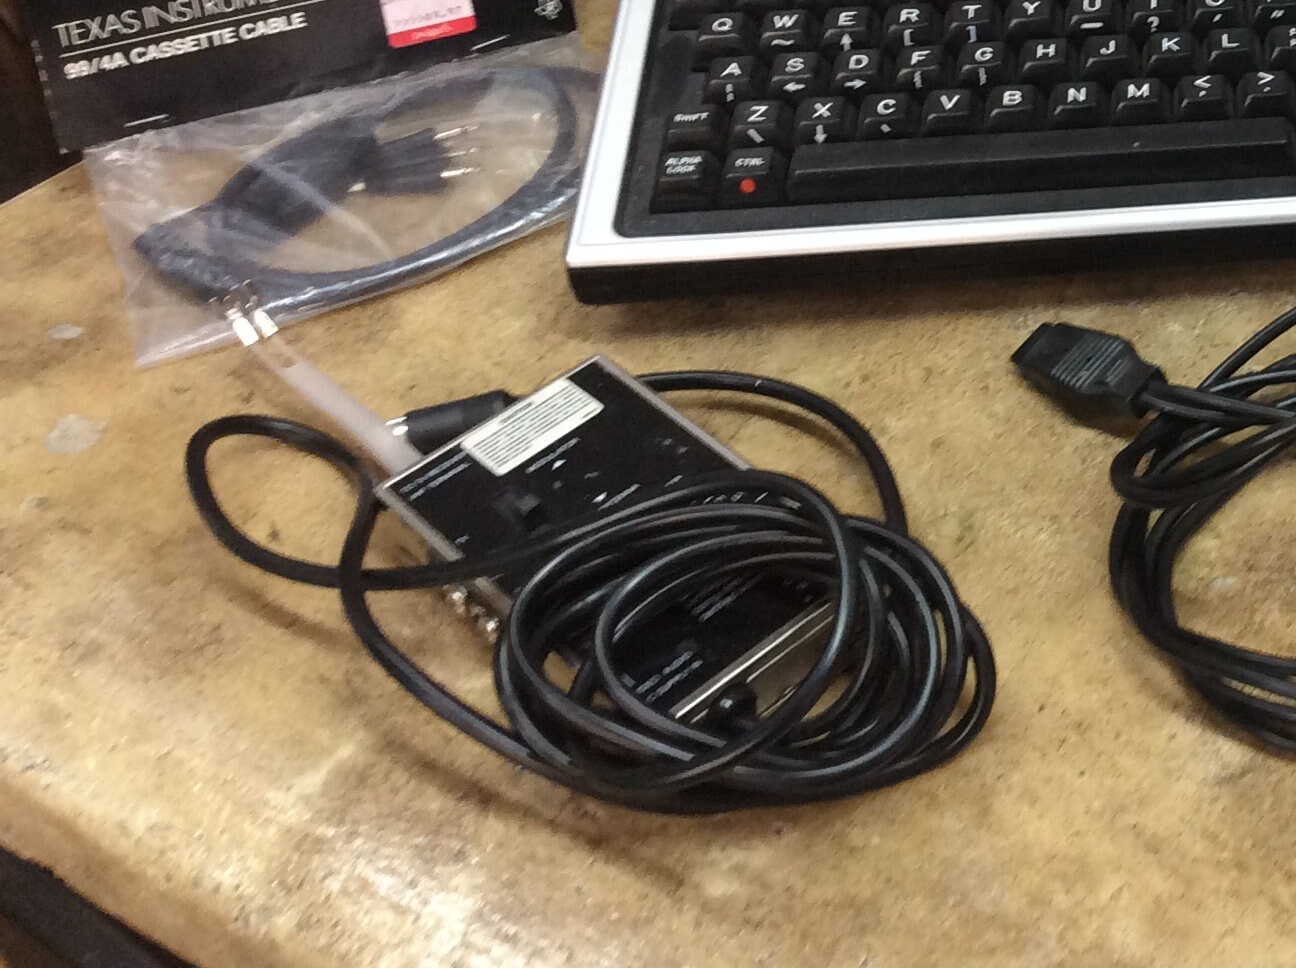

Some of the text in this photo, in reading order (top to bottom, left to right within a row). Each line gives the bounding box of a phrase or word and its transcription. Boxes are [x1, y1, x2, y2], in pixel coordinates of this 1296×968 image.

[899, 8, 920, 23] R
[962, 4, 982, 19] T
[1022, 1, 1041, 15] Y
[711, 17, 733, 31] Q
[773, 14, 799, 29] W
[837, 11, 858, 26] E
[52, 9, 142, 48] TEXAS
[63, 11, 310, 80] 99/4A CASSETTE CABLE
[1099, 39, 1116, 55] J
[1161, 37, 1180, 52] K
[1221, 33, 1240, 48] L
[910, 50, 931, 65] F
[974, 47, 994, 62] G
[1036, 44, 1056, 58] H
[720, 62, 742, 77] A
[785, 57, 805, 72] S
[848, 54, 869, 70] D
[1002, 90, 1022, 106] B
[1067, 87, 1087, 103] N
[1127, 83, 1150, 98] M
[876, 99, 896, 114] C
[940, 94, 961, 110] V
[747, 105, 769, 122] Z
[812, 102, 833, 118] X
